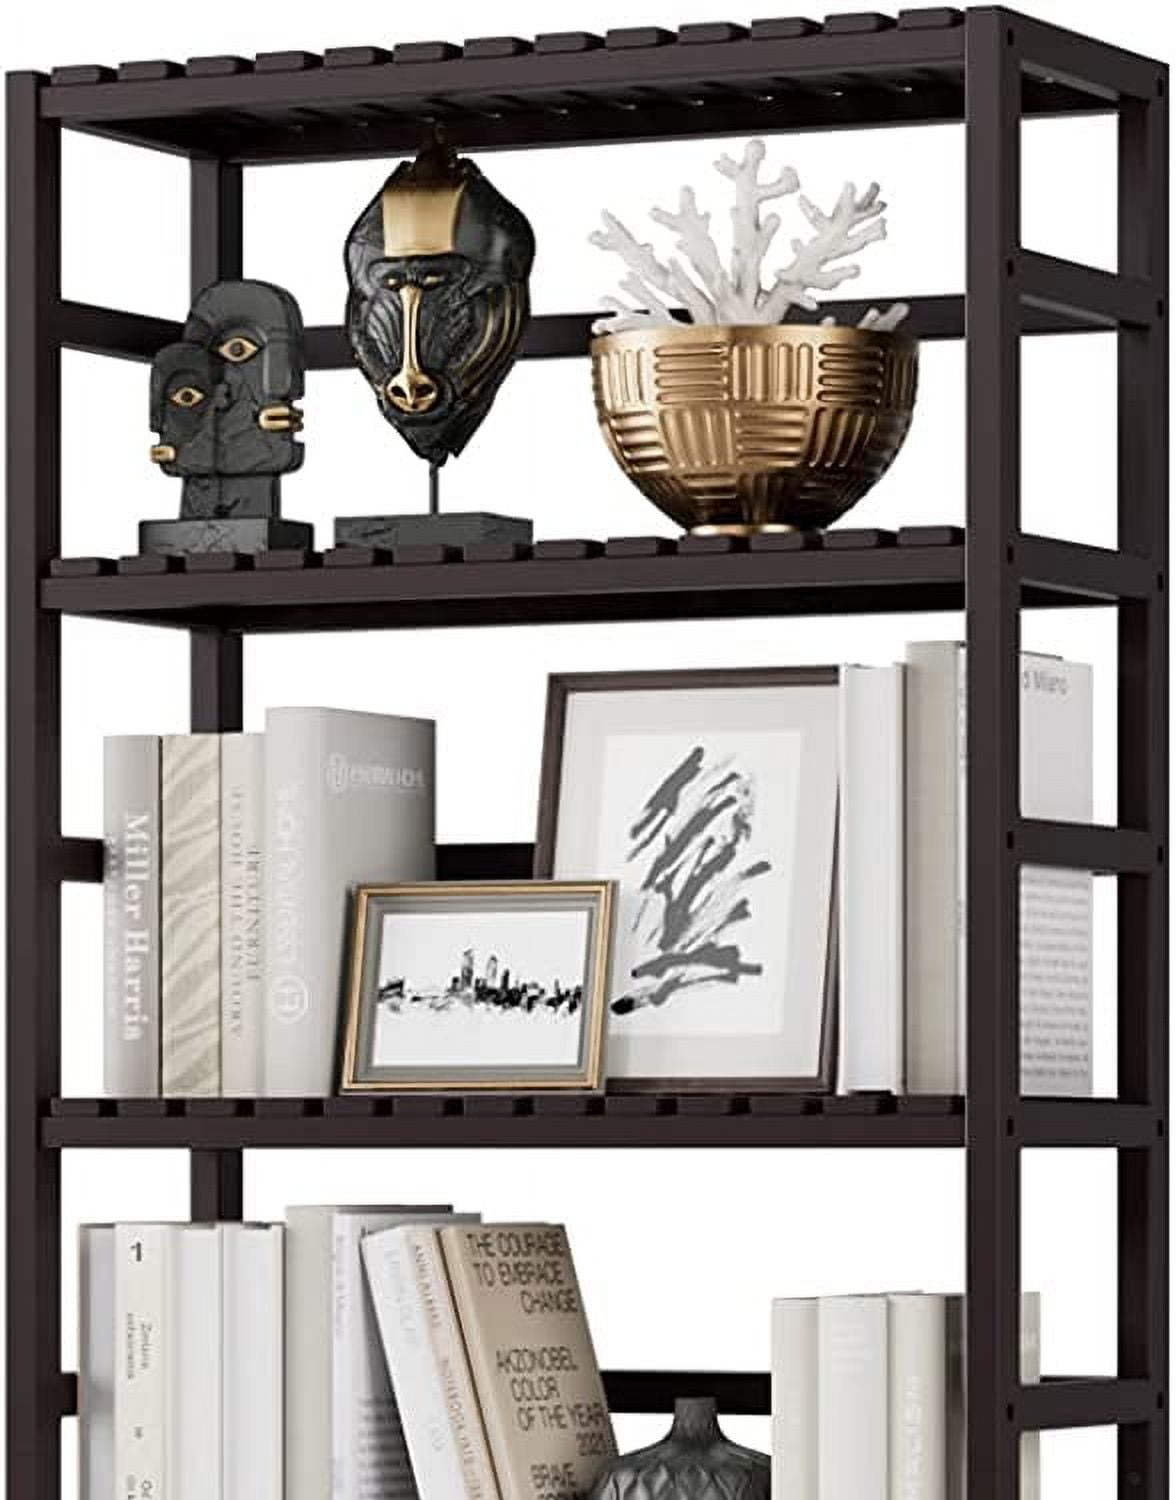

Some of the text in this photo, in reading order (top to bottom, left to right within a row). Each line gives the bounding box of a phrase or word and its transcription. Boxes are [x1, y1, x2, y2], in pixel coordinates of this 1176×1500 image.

[124, 812, 149, 1041] Miller Harris
[247, 846, 261, 982] FURNITURE
[130, 1241, 142, 1262] 1
[467, 1232, 566, 1257] THE COURAGE
[473, 1261, 565, 1287] TO EMBRACE
[520, 1289, 578, 1314] CHANGE
[496, 1346, 578, 1373] AKZONOBEL
[510, 1376, 560, 1402] COLOR
[518, 1402, 605, 1431] OF THE YEAR
[530, 1463, 576, 1488] BRAVE
